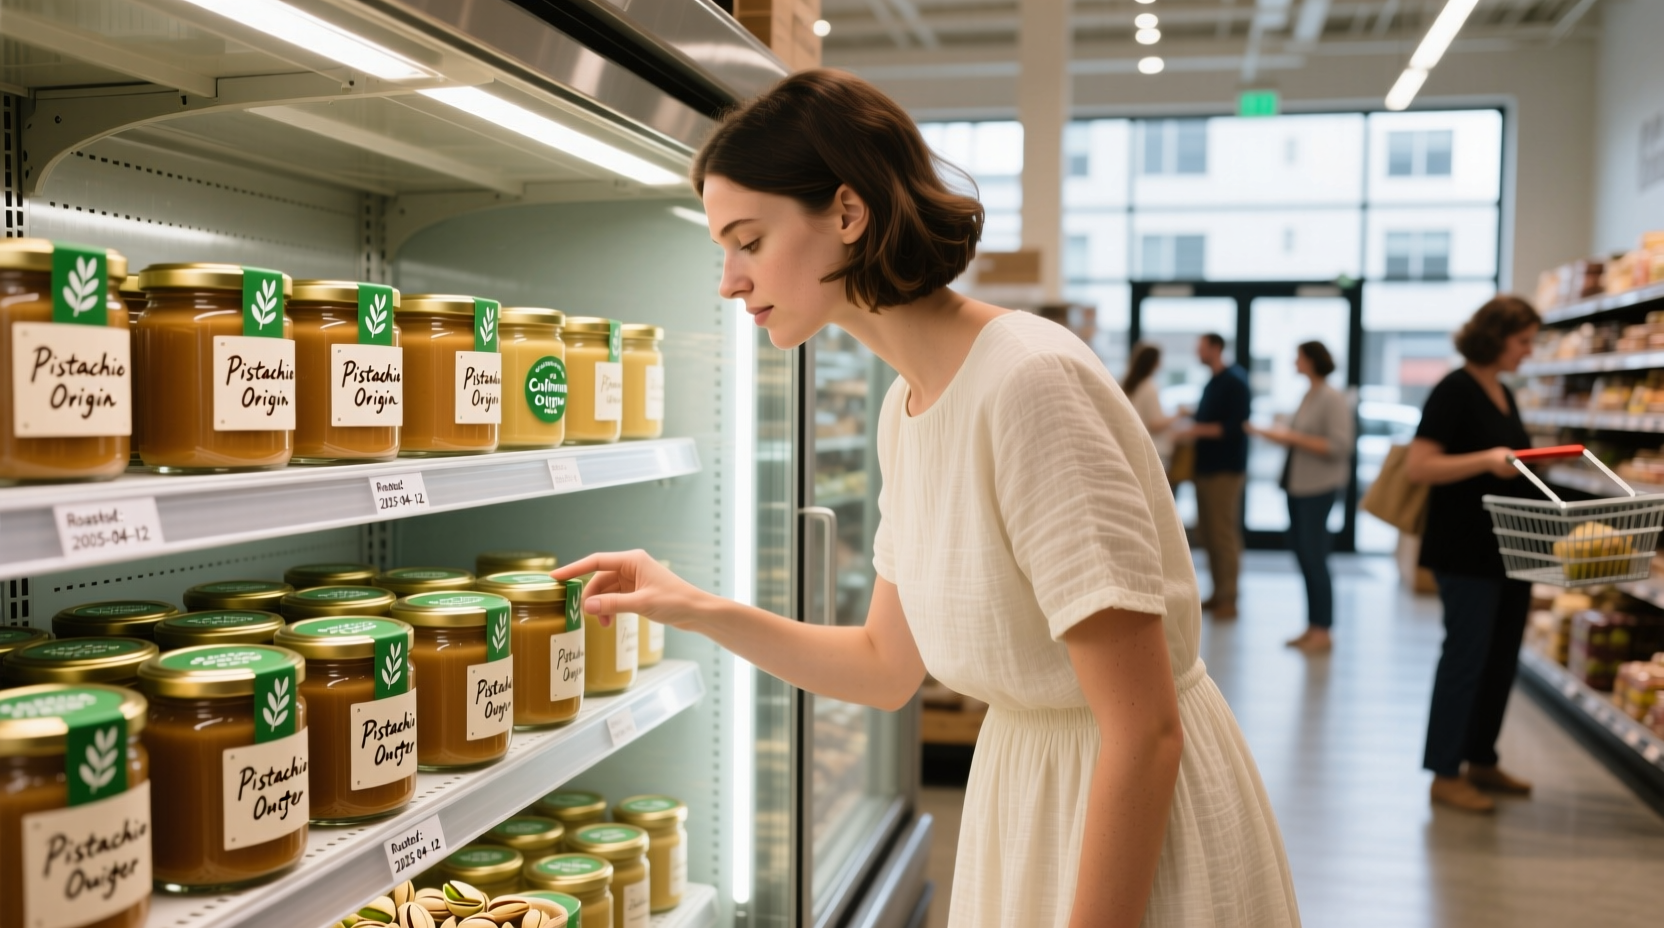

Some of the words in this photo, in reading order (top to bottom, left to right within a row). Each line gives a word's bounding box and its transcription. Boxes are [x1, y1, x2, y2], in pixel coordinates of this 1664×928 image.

[31, 346, 126, 383] Pistachio
[226, 355, 294, 387] Pistachio
[50, 383, 118, 419] Origin
[241, 386, 289, 416] Origin
[354, 387, 399, 414] Origin
